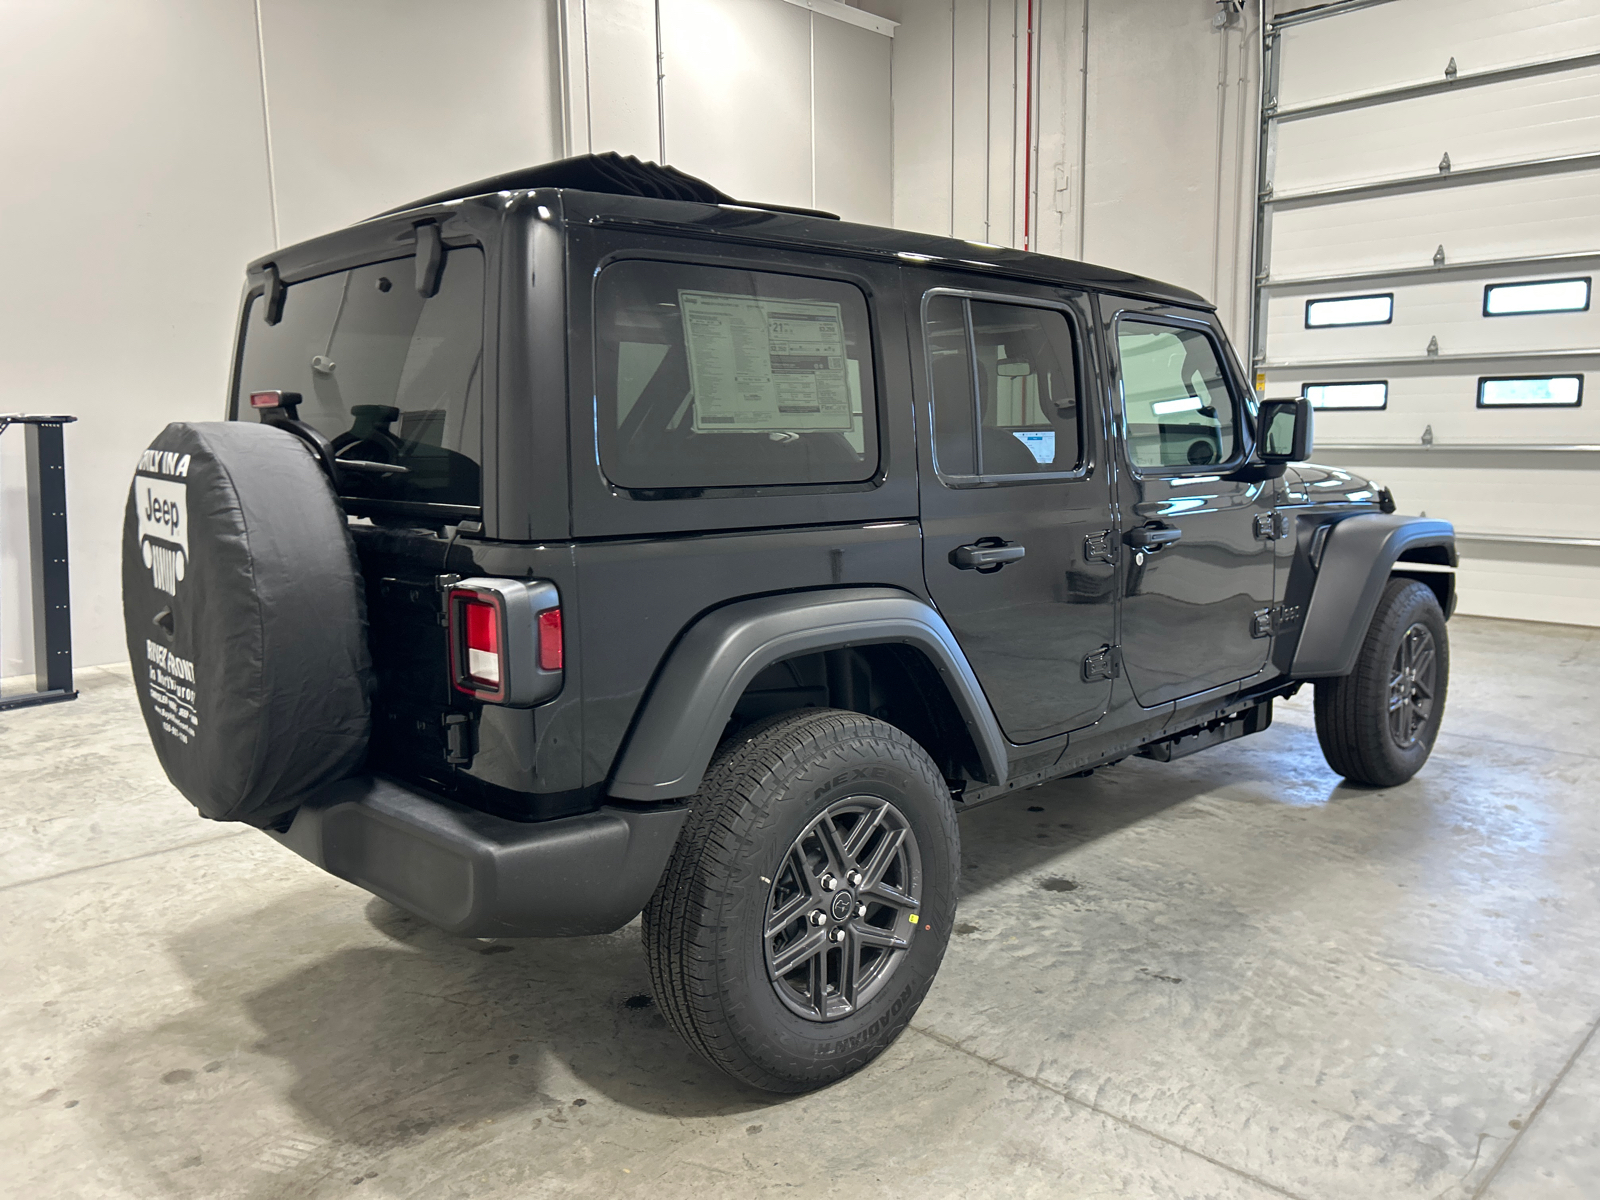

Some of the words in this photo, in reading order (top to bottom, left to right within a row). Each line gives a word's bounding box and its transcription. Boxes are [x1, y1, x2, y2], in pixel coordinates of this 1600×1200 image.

[161, 451, 180, 475] IN
[175, 454, 191, 477] A
[145, 487, 180, 536] Jeep
[166, 651, 196, 685] FRONT
[813, 767, 903, 800] NEXEN
